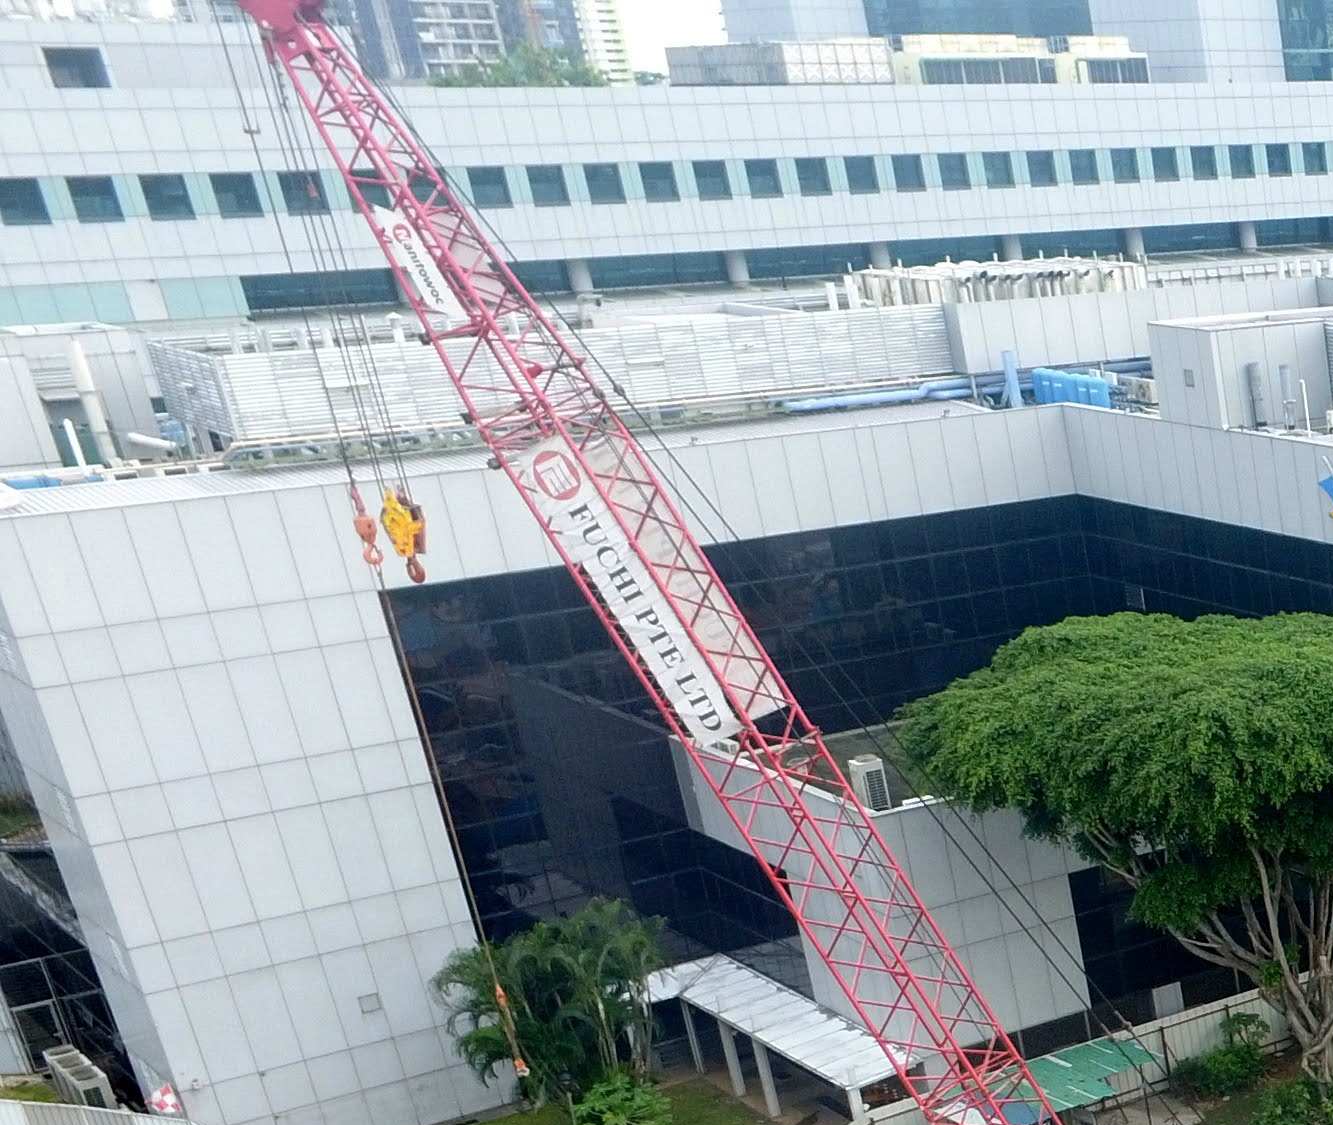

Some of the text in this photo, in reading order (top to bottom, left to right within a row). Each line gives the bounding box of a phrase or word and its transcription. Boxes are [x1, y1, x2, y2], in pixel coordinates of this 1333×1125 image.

[568, 503, 723, 732] FUCHI PTE LTD
